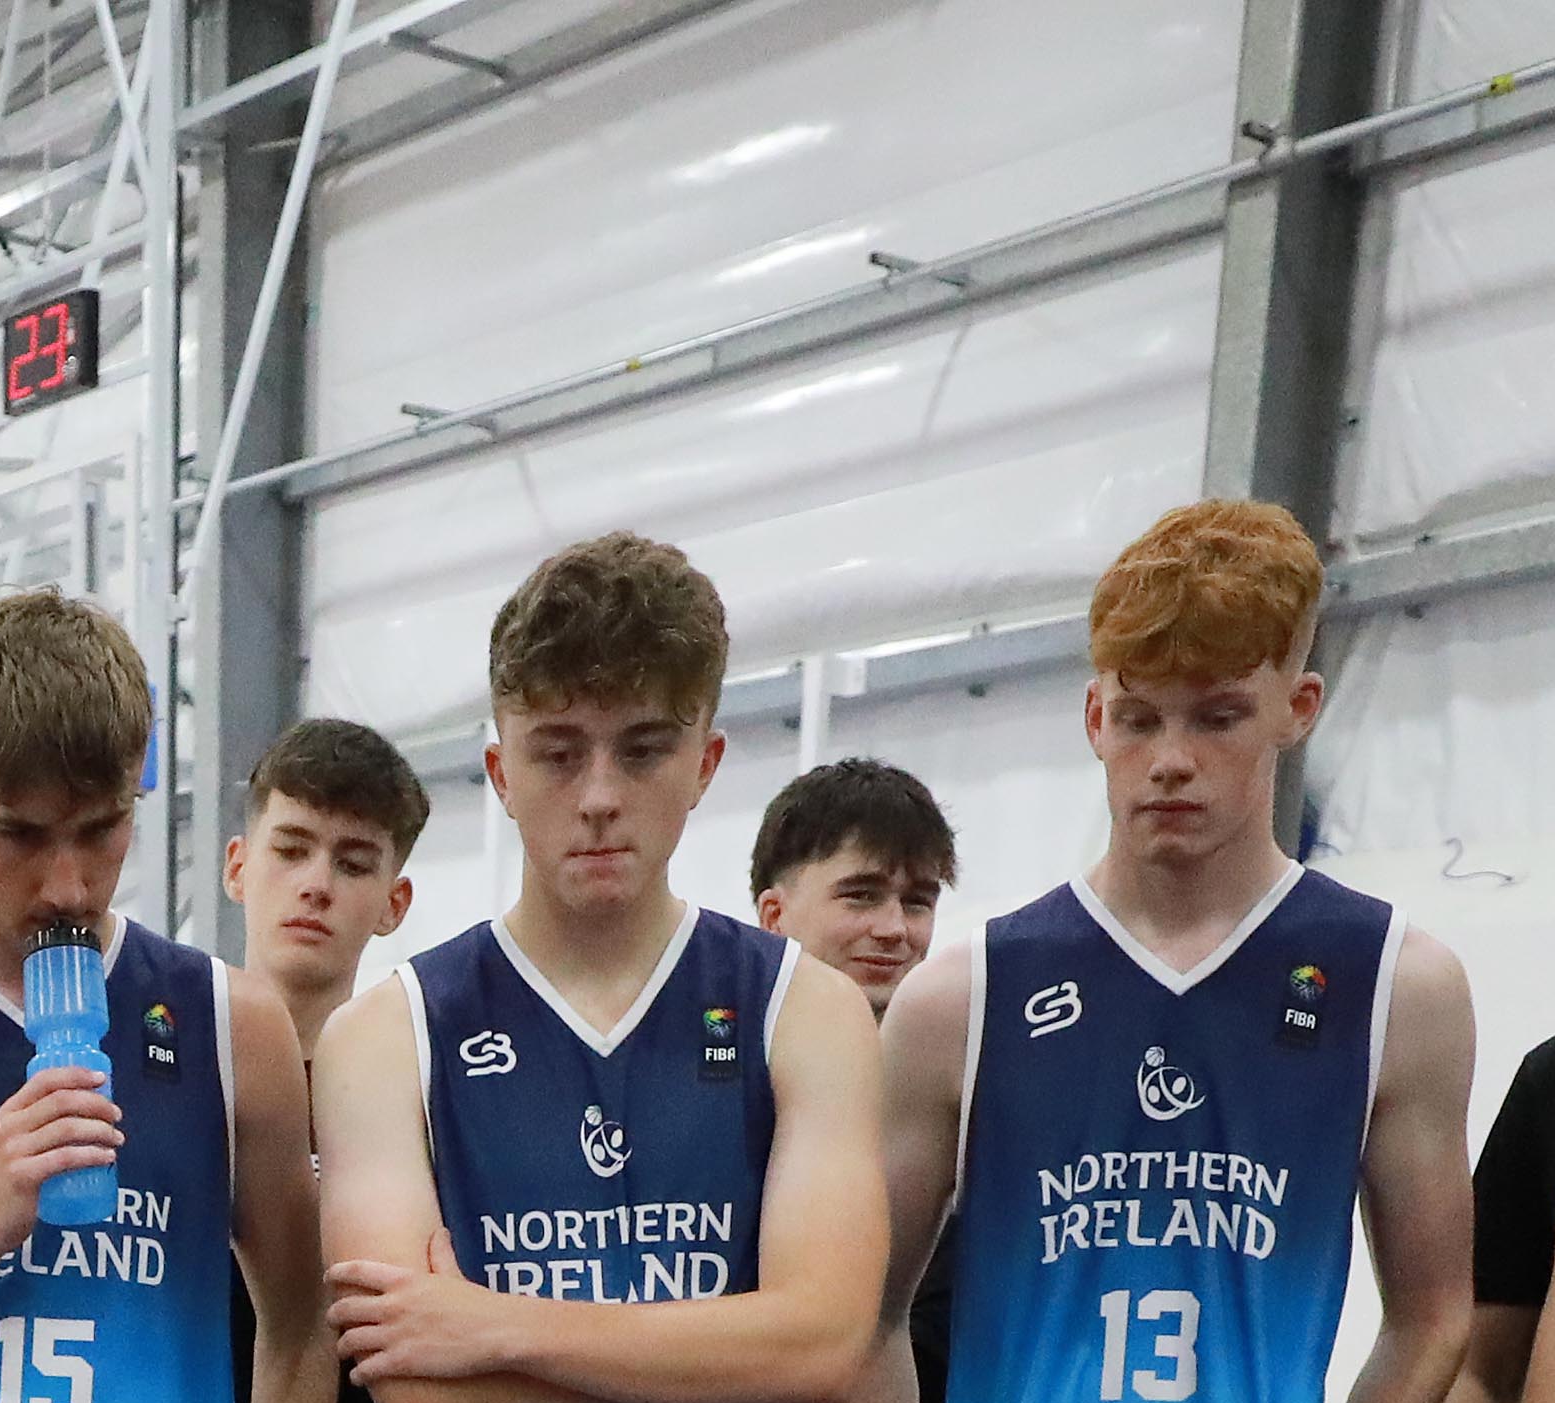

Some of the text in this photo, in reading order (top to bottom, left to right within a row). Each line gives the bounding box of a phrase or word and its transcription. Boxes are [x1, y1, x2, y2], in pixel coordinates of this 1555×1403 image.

[8, 303, 69, 400] 23
[1285, 1008, 1316, 1030] FIBA
[148, 1045, 175, 1064] FIBA
[705, 1046, 737, 1062] FIBA
[1038, 1152, 1289, 1206] NORTHERN
[1039, 1199, 1277, 1264] IRELAND
[484, 1252, 729, 1304] IRELND
[1100, 1289, 1201, 1401] 13
